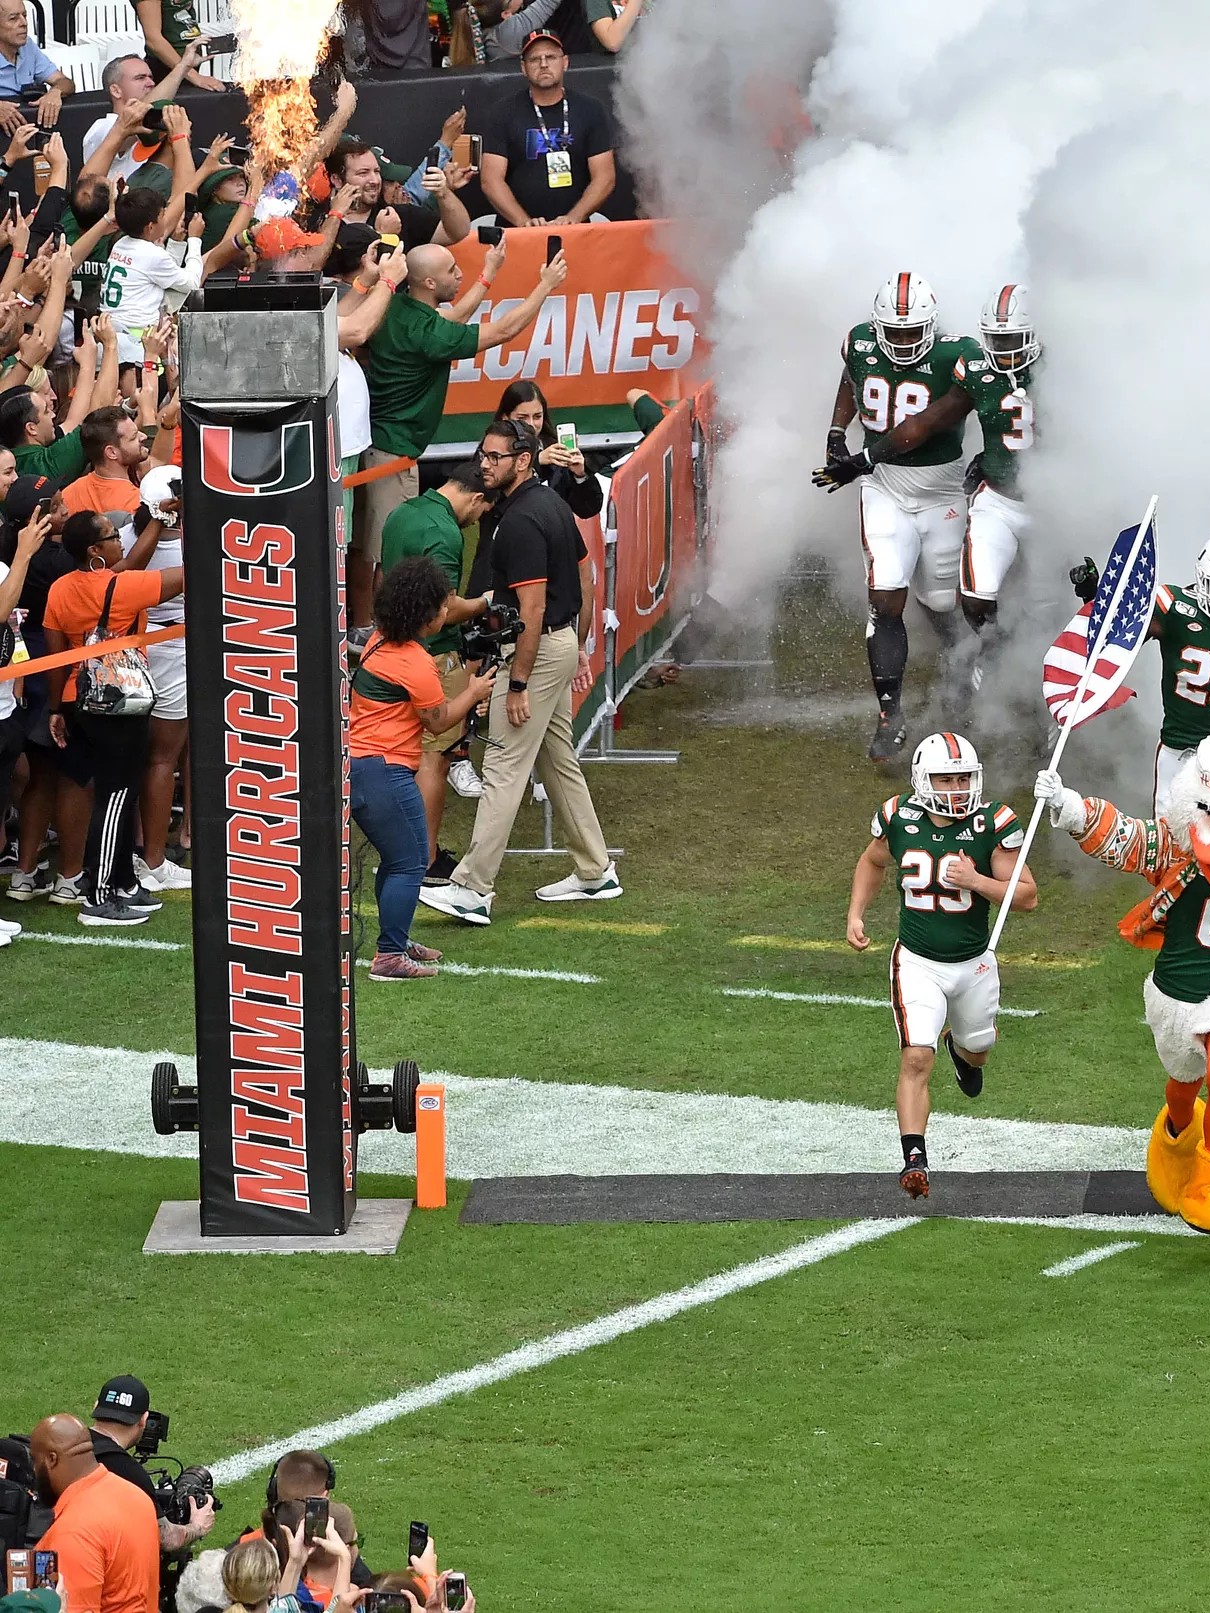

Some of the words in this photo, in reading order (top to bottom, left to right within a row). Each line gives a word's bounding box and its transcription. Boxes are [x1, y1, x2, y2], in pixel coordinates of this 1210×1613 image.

[73, 260, 108, 279] RDUY
[439, 287, 700, 384] ICANES
[861, 374, 931, 433] 98
[200, 420, 315, 496] U
[221, 518, 304, 956] HURRICANES
[972, 814, 985, 833] C
[228, 961, 311, 1214] MIAMI
[105, 1390, 133, 1407] E:60
